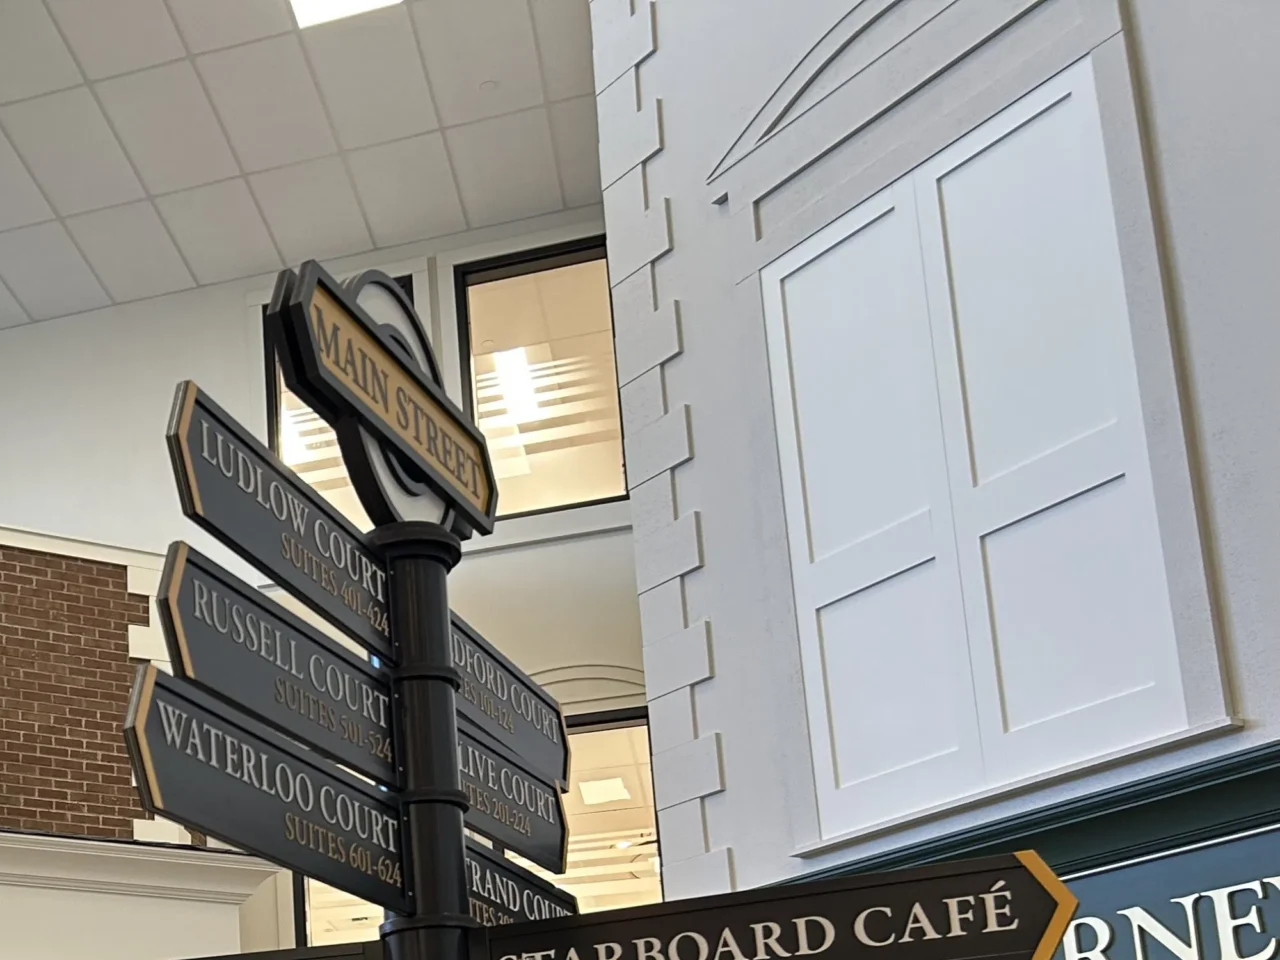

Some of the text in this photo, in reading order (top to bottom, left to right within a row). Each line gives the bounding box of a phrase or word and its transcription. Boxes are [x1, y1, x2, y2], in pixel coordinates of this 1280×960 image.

[314, 303, 481, 500] MAIN STREET
[200, 418, 387, 604] LUDLOW COURT
[281, 531, 390, 638] SUITES 401-424
[192, 577, 389, 729] RUSSELL COURT
[452, 634, 558, 744] DFORD COURT
[275, 676, 392, 763] SUITES 501-524
[156, 698, 398, 853] WATERLOO COURT
[457, 741, 555, 824] LIVE COURT
[492, 798, 532, 837] 201-224
[285, 812, 402, 888] SUITES 601-624
[465, 857, 520, 912] RAND
[854, 880, 1019, 947] CAFÉ
